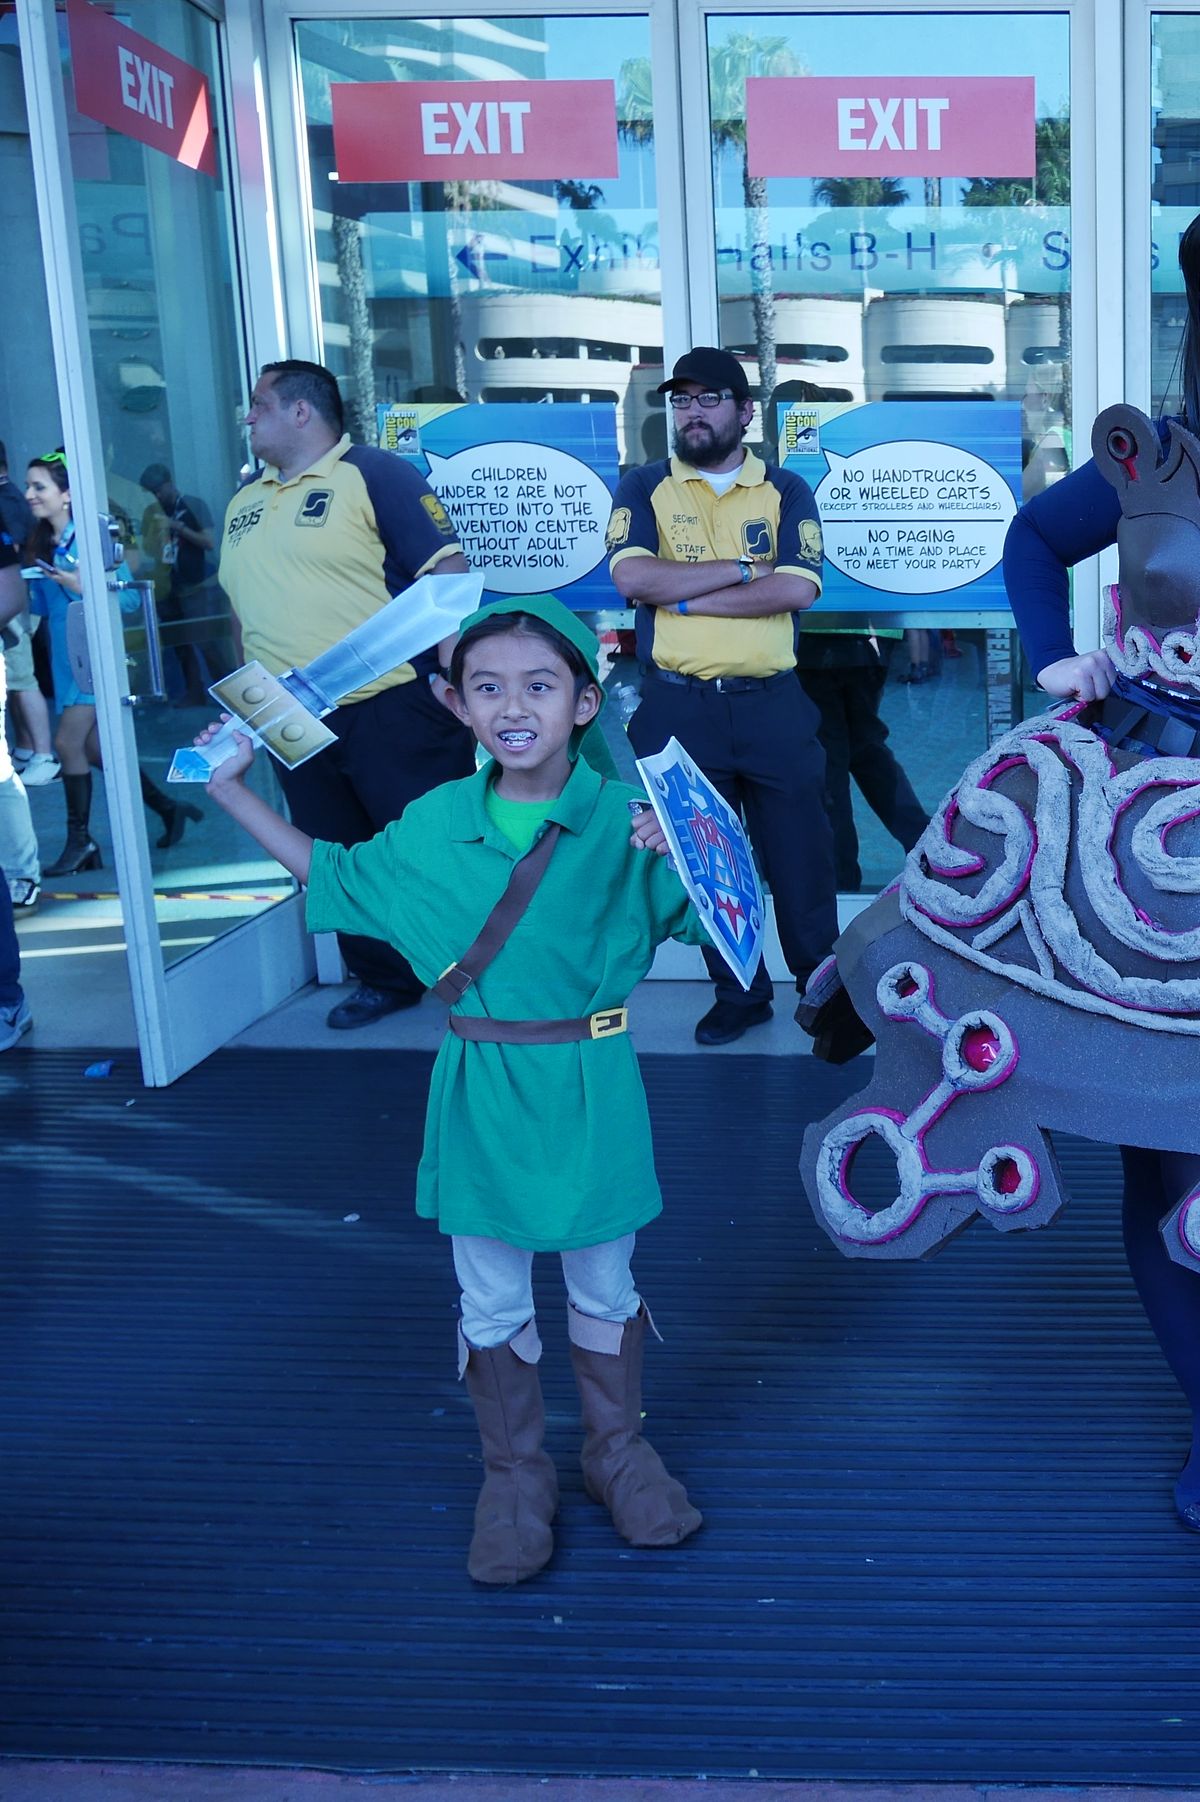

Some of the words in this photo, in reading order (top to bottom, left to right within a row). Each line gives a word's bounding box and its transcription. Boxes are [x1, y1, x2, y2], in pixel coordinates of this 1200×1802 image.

[118, 46, 175, 129] EXIT
[421, 101, 531, 155] EXIT
[837, 98, 949, 151] EXIT
[850, 231, 937, 271] B-H
[397, 418, 417, 429] CON
[797, 416, 817, 428] CON
[386, 418, 398, 449] COMIC
[786, 416, 797, 448] COMIC
[471, 467, 547, 482] CHILDREN
[843, 469, 864, 483] NO
[873, 469, 977, 483] HANDTRUCKS
[434, 485, 486, 499] UNDER
[494, 485, 509, 499] 12
[517, 485, 546, 499] ARE
[554, 485, 587, 499] NOT
[830, 487, 851, 500] OR
[859, 487, 929, 500] WHEELED
[937, 487, 991, 500] CARTS
[443, 502, 508, 516] DMITTED
[517, 502, 553, 516] INTO
[561, 502, 593, 516] THE
[820, 502, 858, 511] (EXCEPT
[862, 502, 913, 511] STROLLERS
[917, 502, 935, 511] AND
[938, 502, 1002, 511] WHEELCHAIRS)
[454, 520, 527, 533] NVENTION
[535, 520, 598, 533] CENTER
[868, 530, 889, 543] NO
[898, 530, 955, 543] PAGING
[459, 537, 520, 551] ITHOUT
[527, 537, 578, 551] ADULT
[676, 543, 706, 555] STAFF
[837, 546, 867, 556] PLAN
[872, 546, 880, 556] A
[886, 546, 914, 556] TIME
[920, 546, 943, 556] AND
[948, 546, 987, 556] PLACE
[466, 554, 569, 568] SUPERVISION.
[844, 559, 861, 569] TO
[867, 559, 900, 569] MEET
[905, 559, 936, 569] YOUR
[942, 559, 981, 569] PARTY
[987, 629, 1010, 674] FEAR
